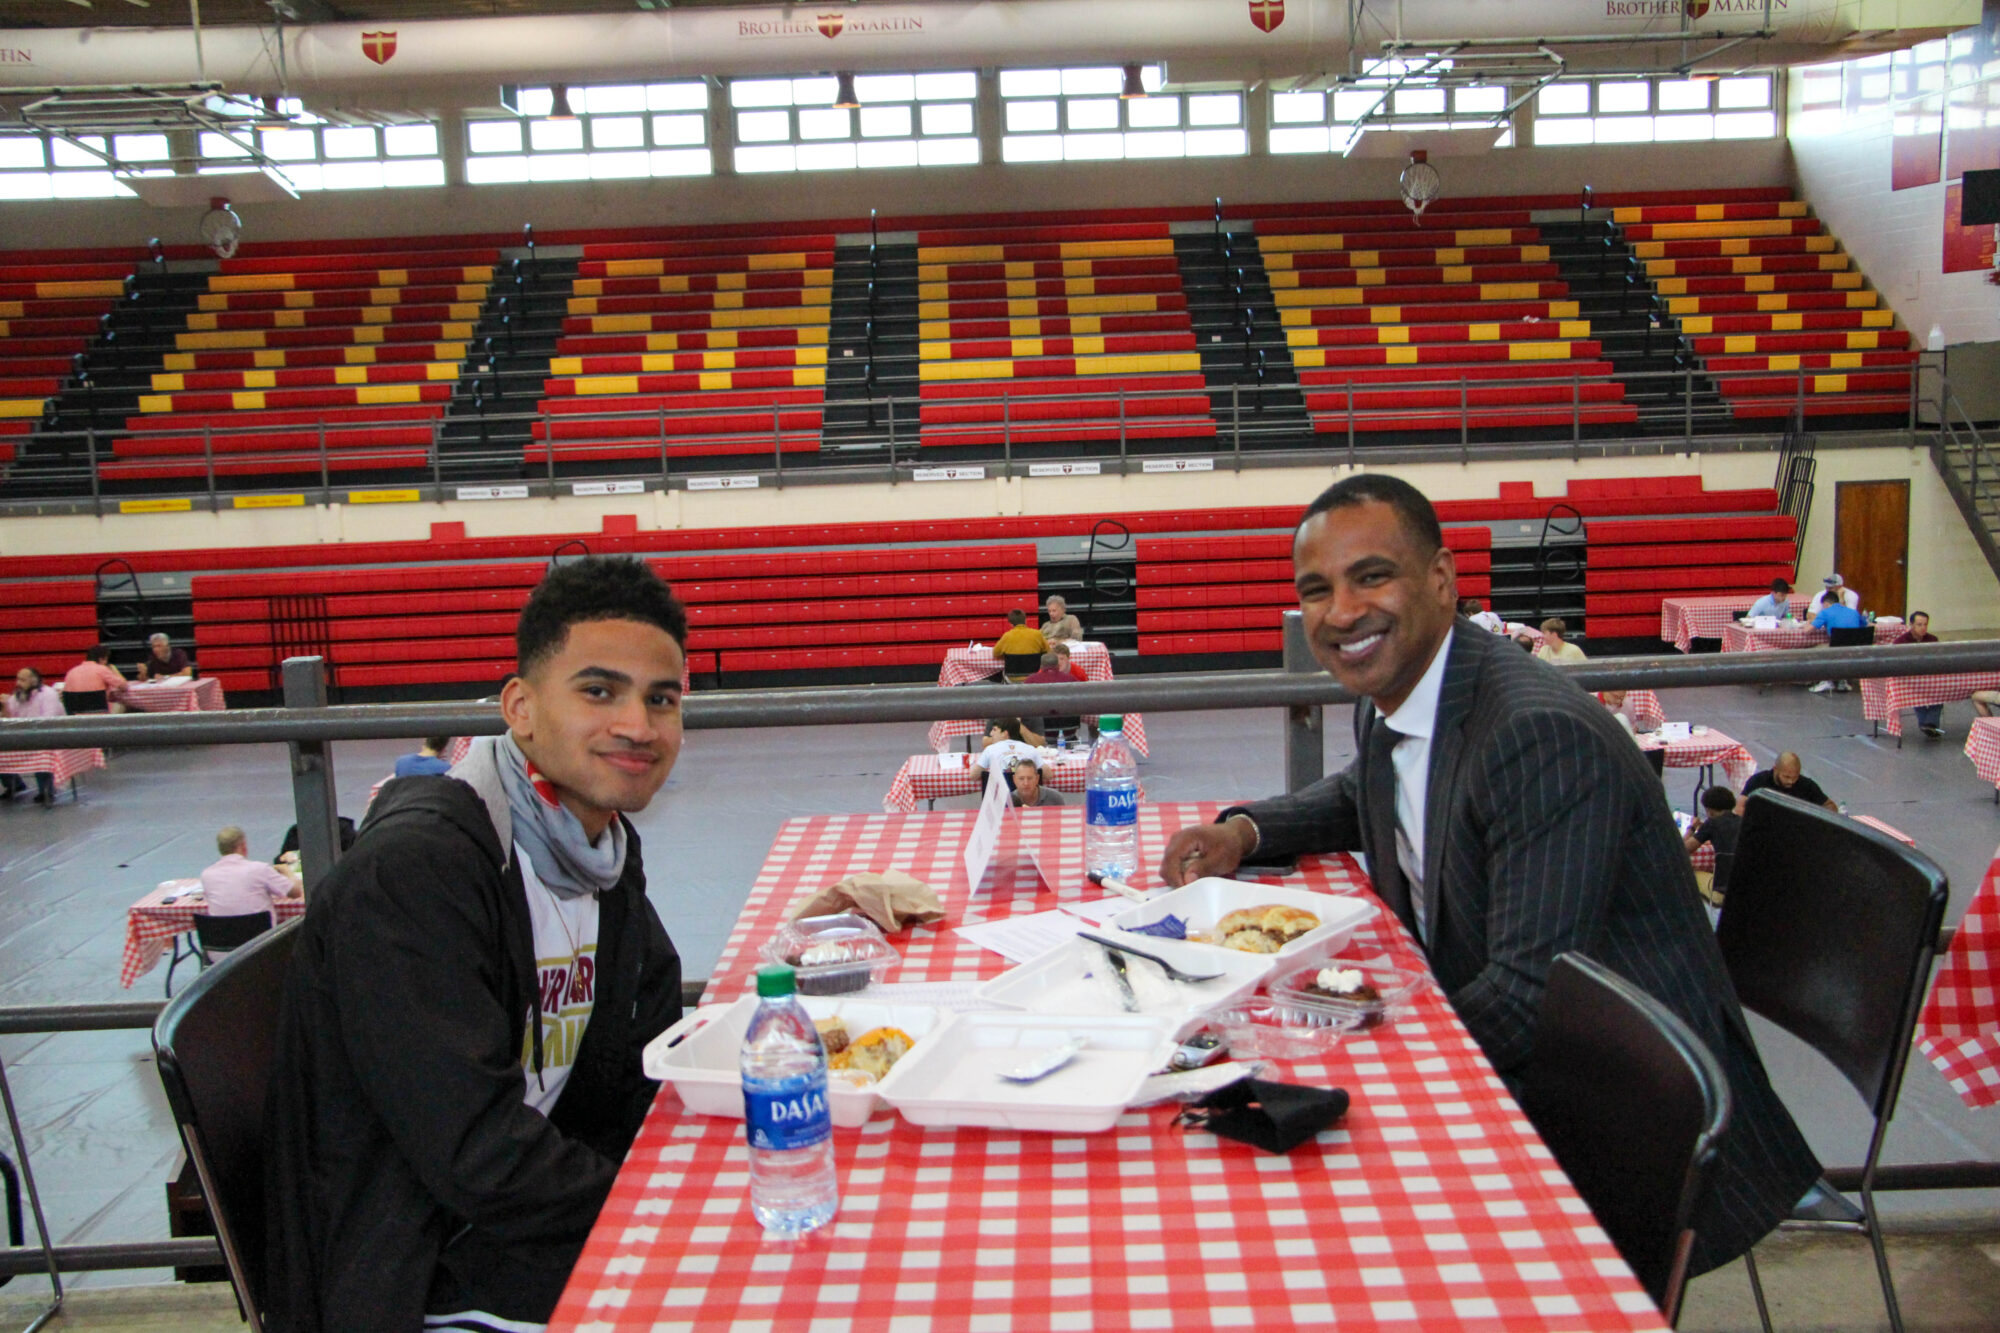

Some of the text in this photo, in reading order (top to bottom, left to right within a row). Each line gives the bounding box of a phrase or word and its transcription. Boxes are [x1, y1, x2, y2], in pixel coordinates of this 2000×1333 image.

[1606, 0, 1787, 16] BROTHER MARTN
[738, 16, 922, 36] BROTHER MARTIN
[771, 1091, 827, 1122] DASA
